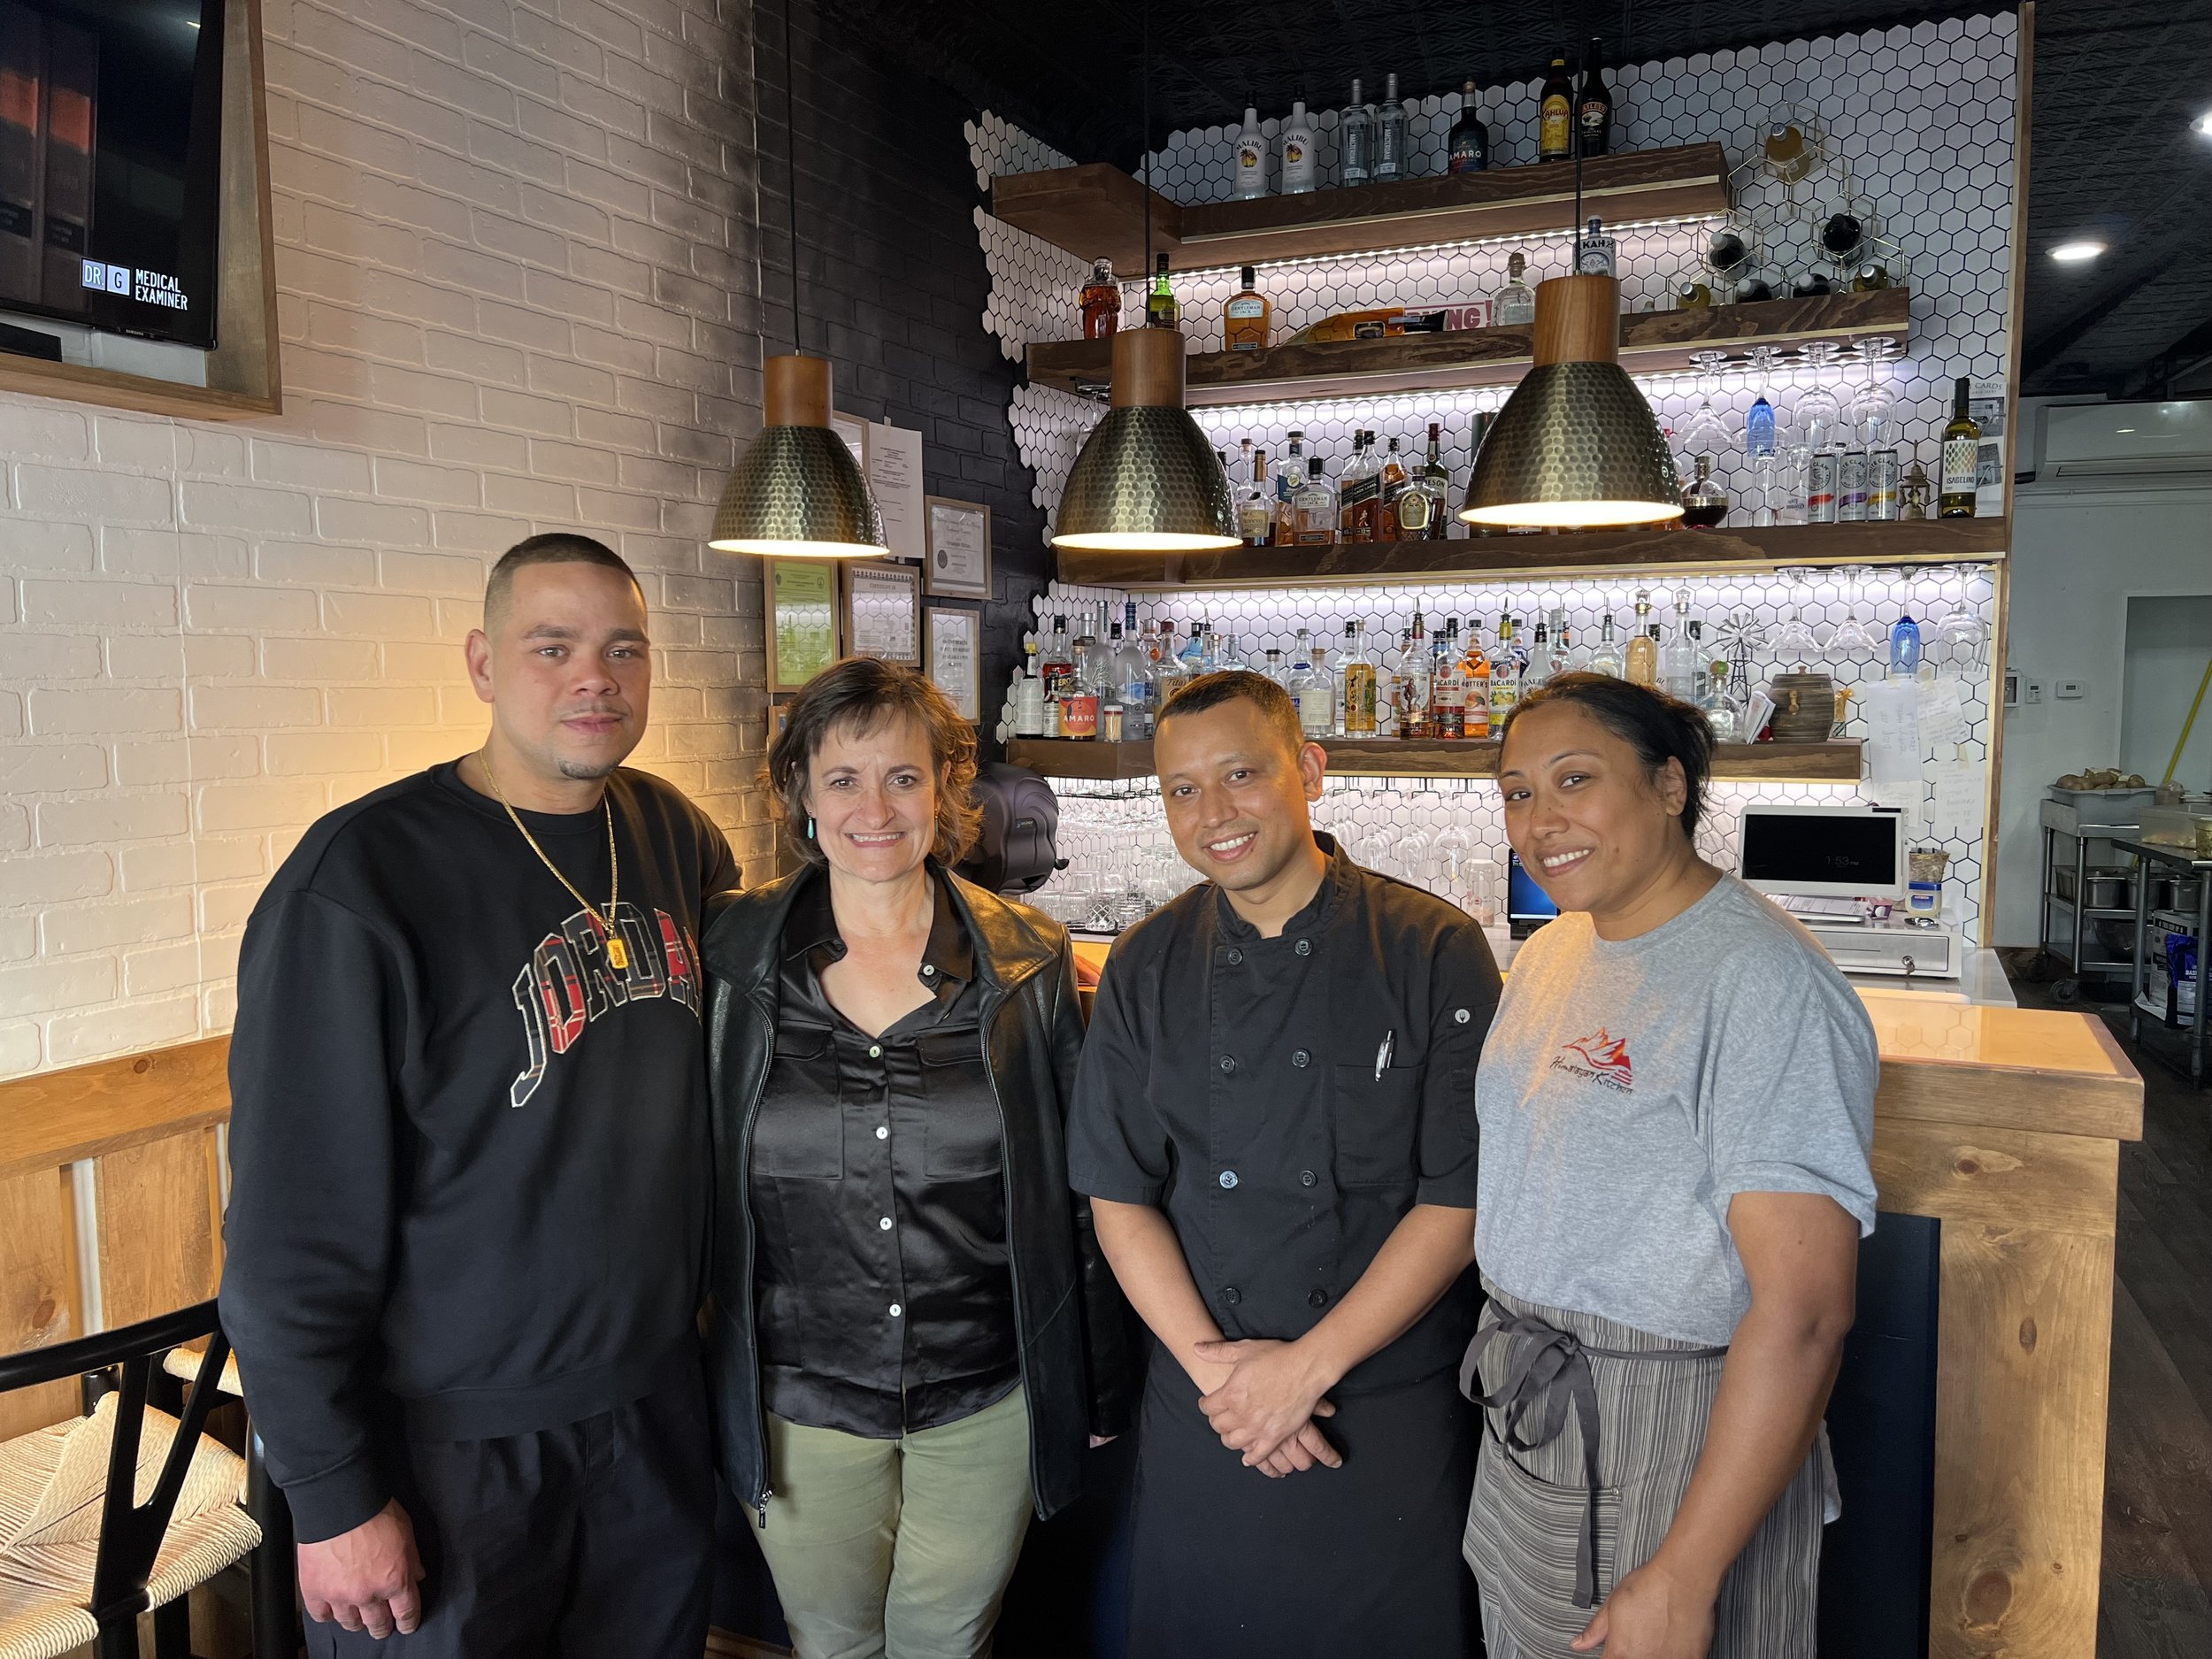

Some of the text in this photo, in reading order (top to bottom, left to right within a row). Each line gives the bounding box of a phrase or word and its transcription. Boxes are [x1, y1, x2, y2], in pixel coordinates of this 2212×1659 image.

[1236, 140, 1263, 151] MALIBU
[1283, 134, 1310, 146] MALIBU
[1449, 150, 1482, 161] AMARO
[1582, 240, 1605, 250] KAH
[84, 265, 122, 289] DR. G
[135, 268, 181, 294] MEDICAL
[135, 285, 188, 311] EXAMINER
[1849, 459, 1865, 468] CLAW
[1549, 1056, 1634, 1094] Himalayan Kitchen
